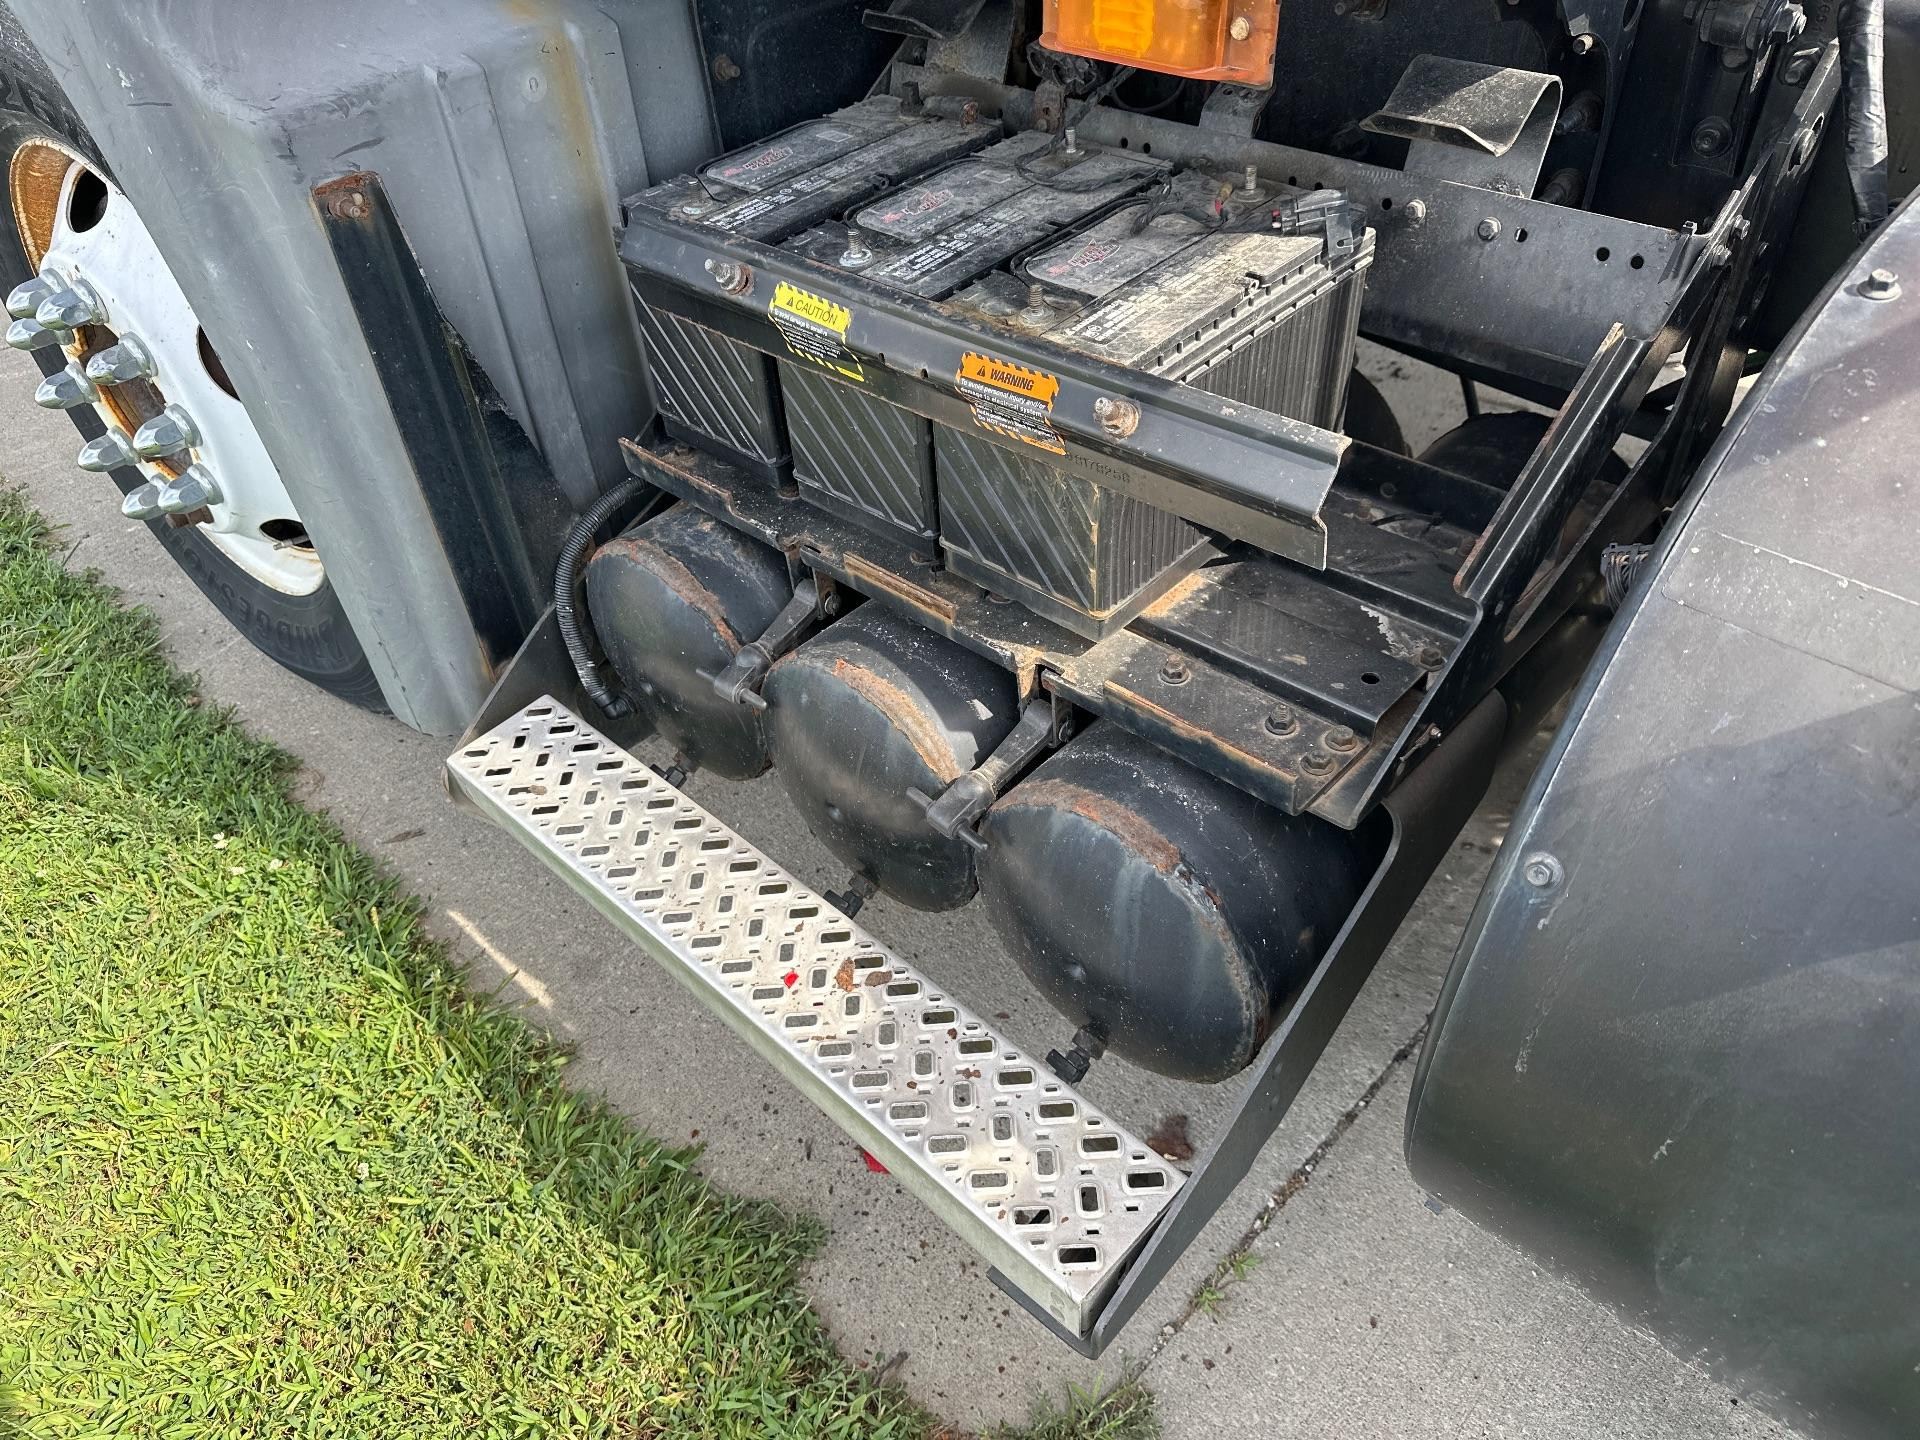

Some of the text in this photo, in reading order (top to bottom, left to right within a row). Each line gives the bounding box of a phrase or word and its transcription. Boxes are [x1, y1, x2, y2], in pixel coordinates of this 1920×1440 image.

[796, 299, 838, 325] CAUTION
[968, 381, 984, 391] avoid
[984, 385, 1009, 399] personal
[990, 368, 1035, 391] WARNING
